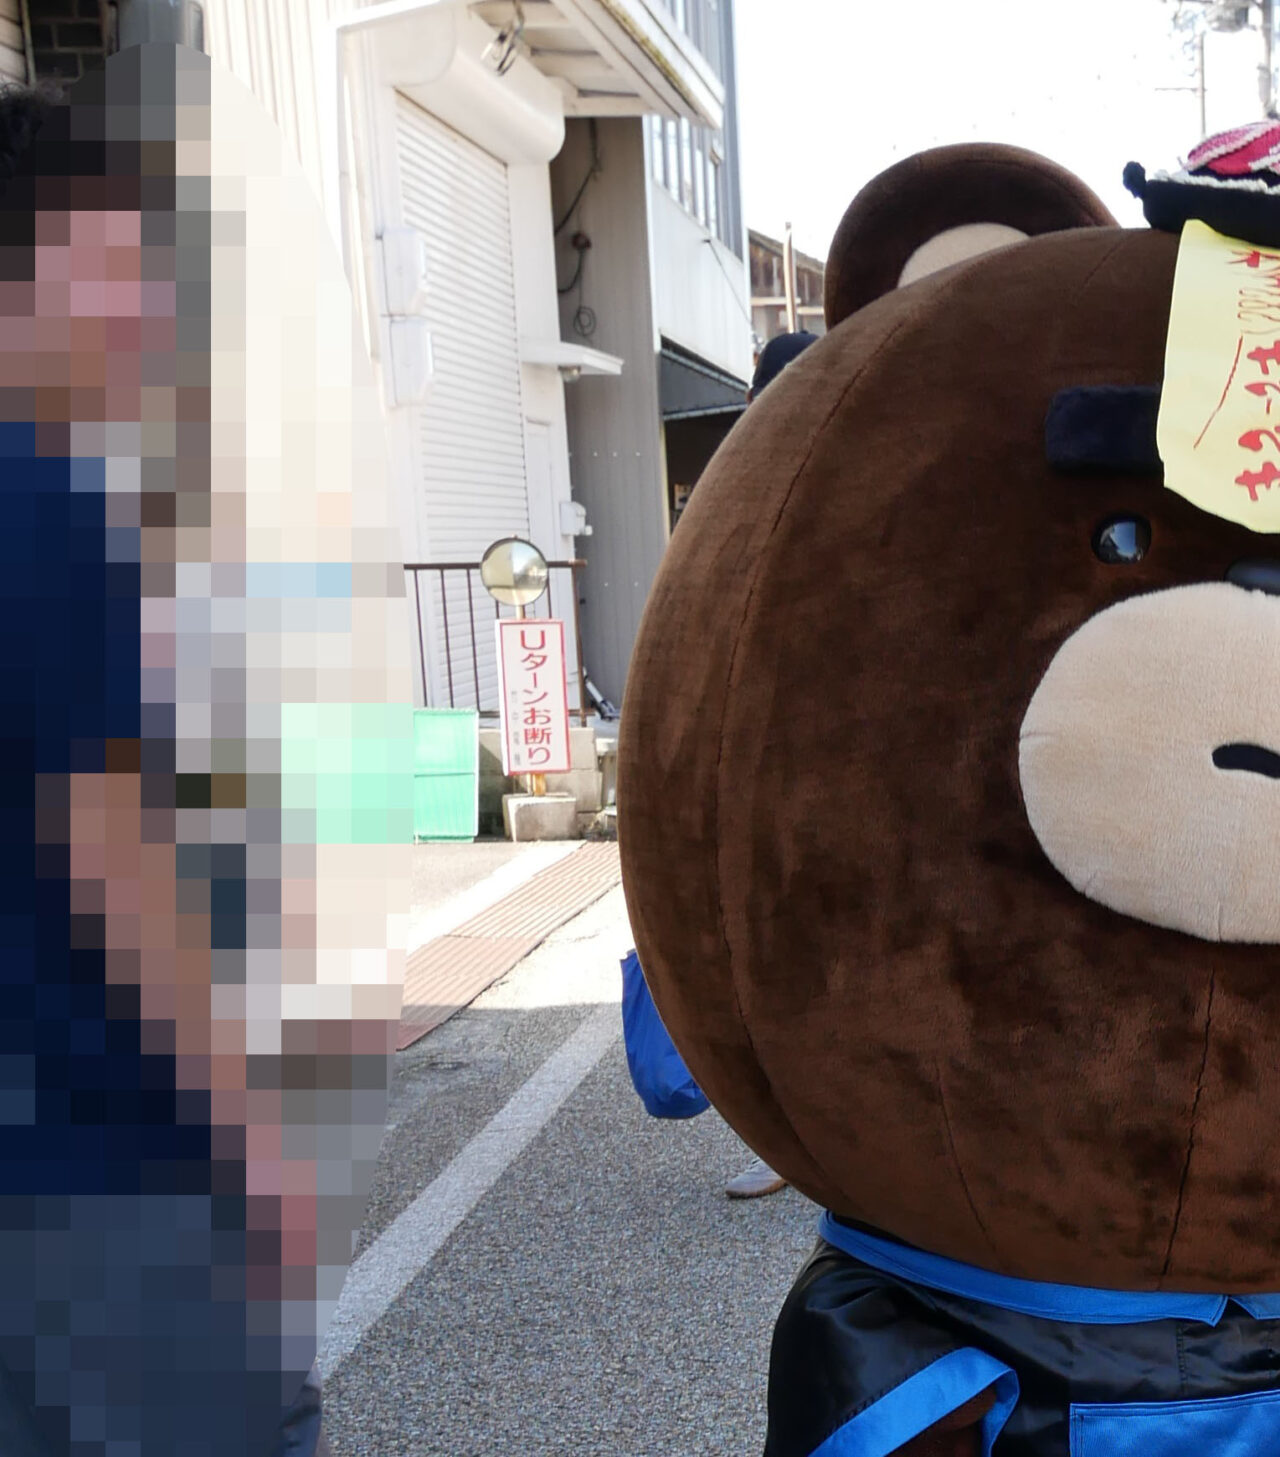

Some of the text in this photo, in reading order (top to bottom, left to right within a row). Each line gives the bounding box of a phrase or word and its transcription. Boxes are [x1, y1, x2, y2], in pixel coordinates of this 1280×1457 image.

[520, 630, 552, 766] Uターンお断り
